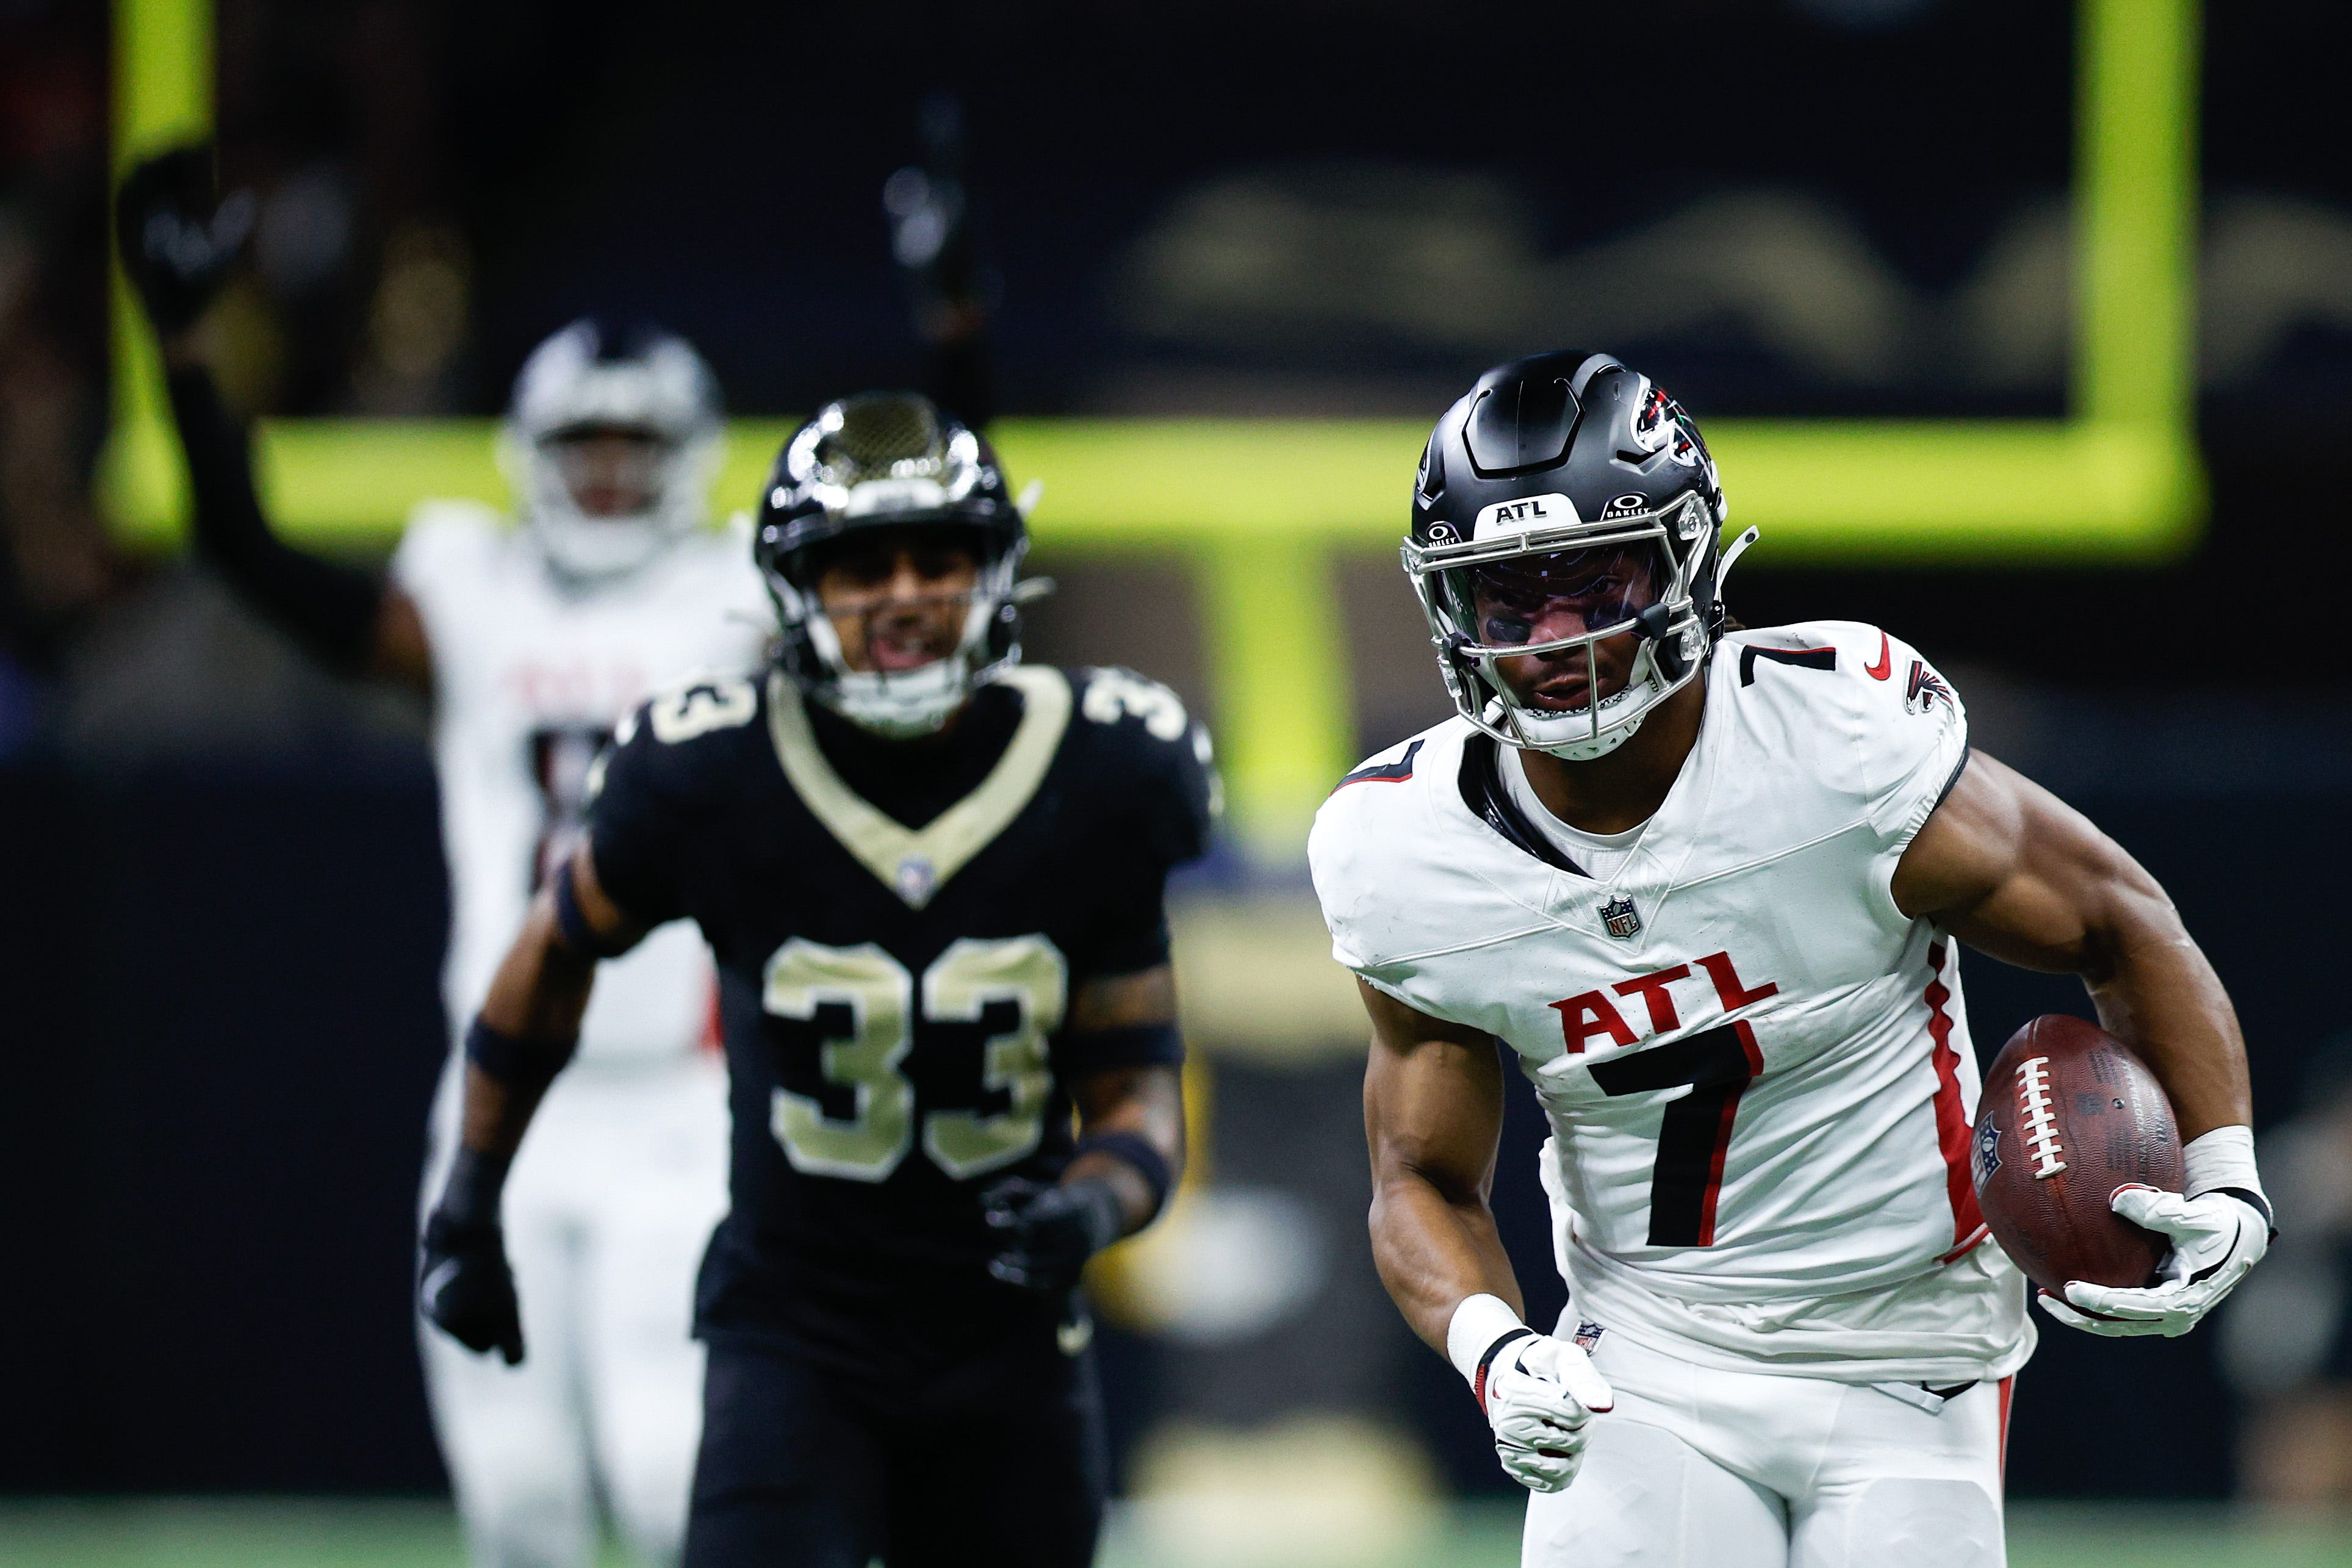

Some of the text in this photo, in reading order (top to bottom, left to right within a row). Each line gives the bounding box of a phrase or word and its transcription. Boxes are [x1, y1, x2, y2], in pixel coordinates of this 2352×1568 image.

[1496, 501, 1547, 523] ATL
[1606, 508, 1649, 518] OAKLEY
[1609, 915, 1637, 935] NFL
[1548, 951, 1778, 1054] ATL
[763, 933, 1068, 1183] 33
[1587, 1019, 1764, 1246] 7
